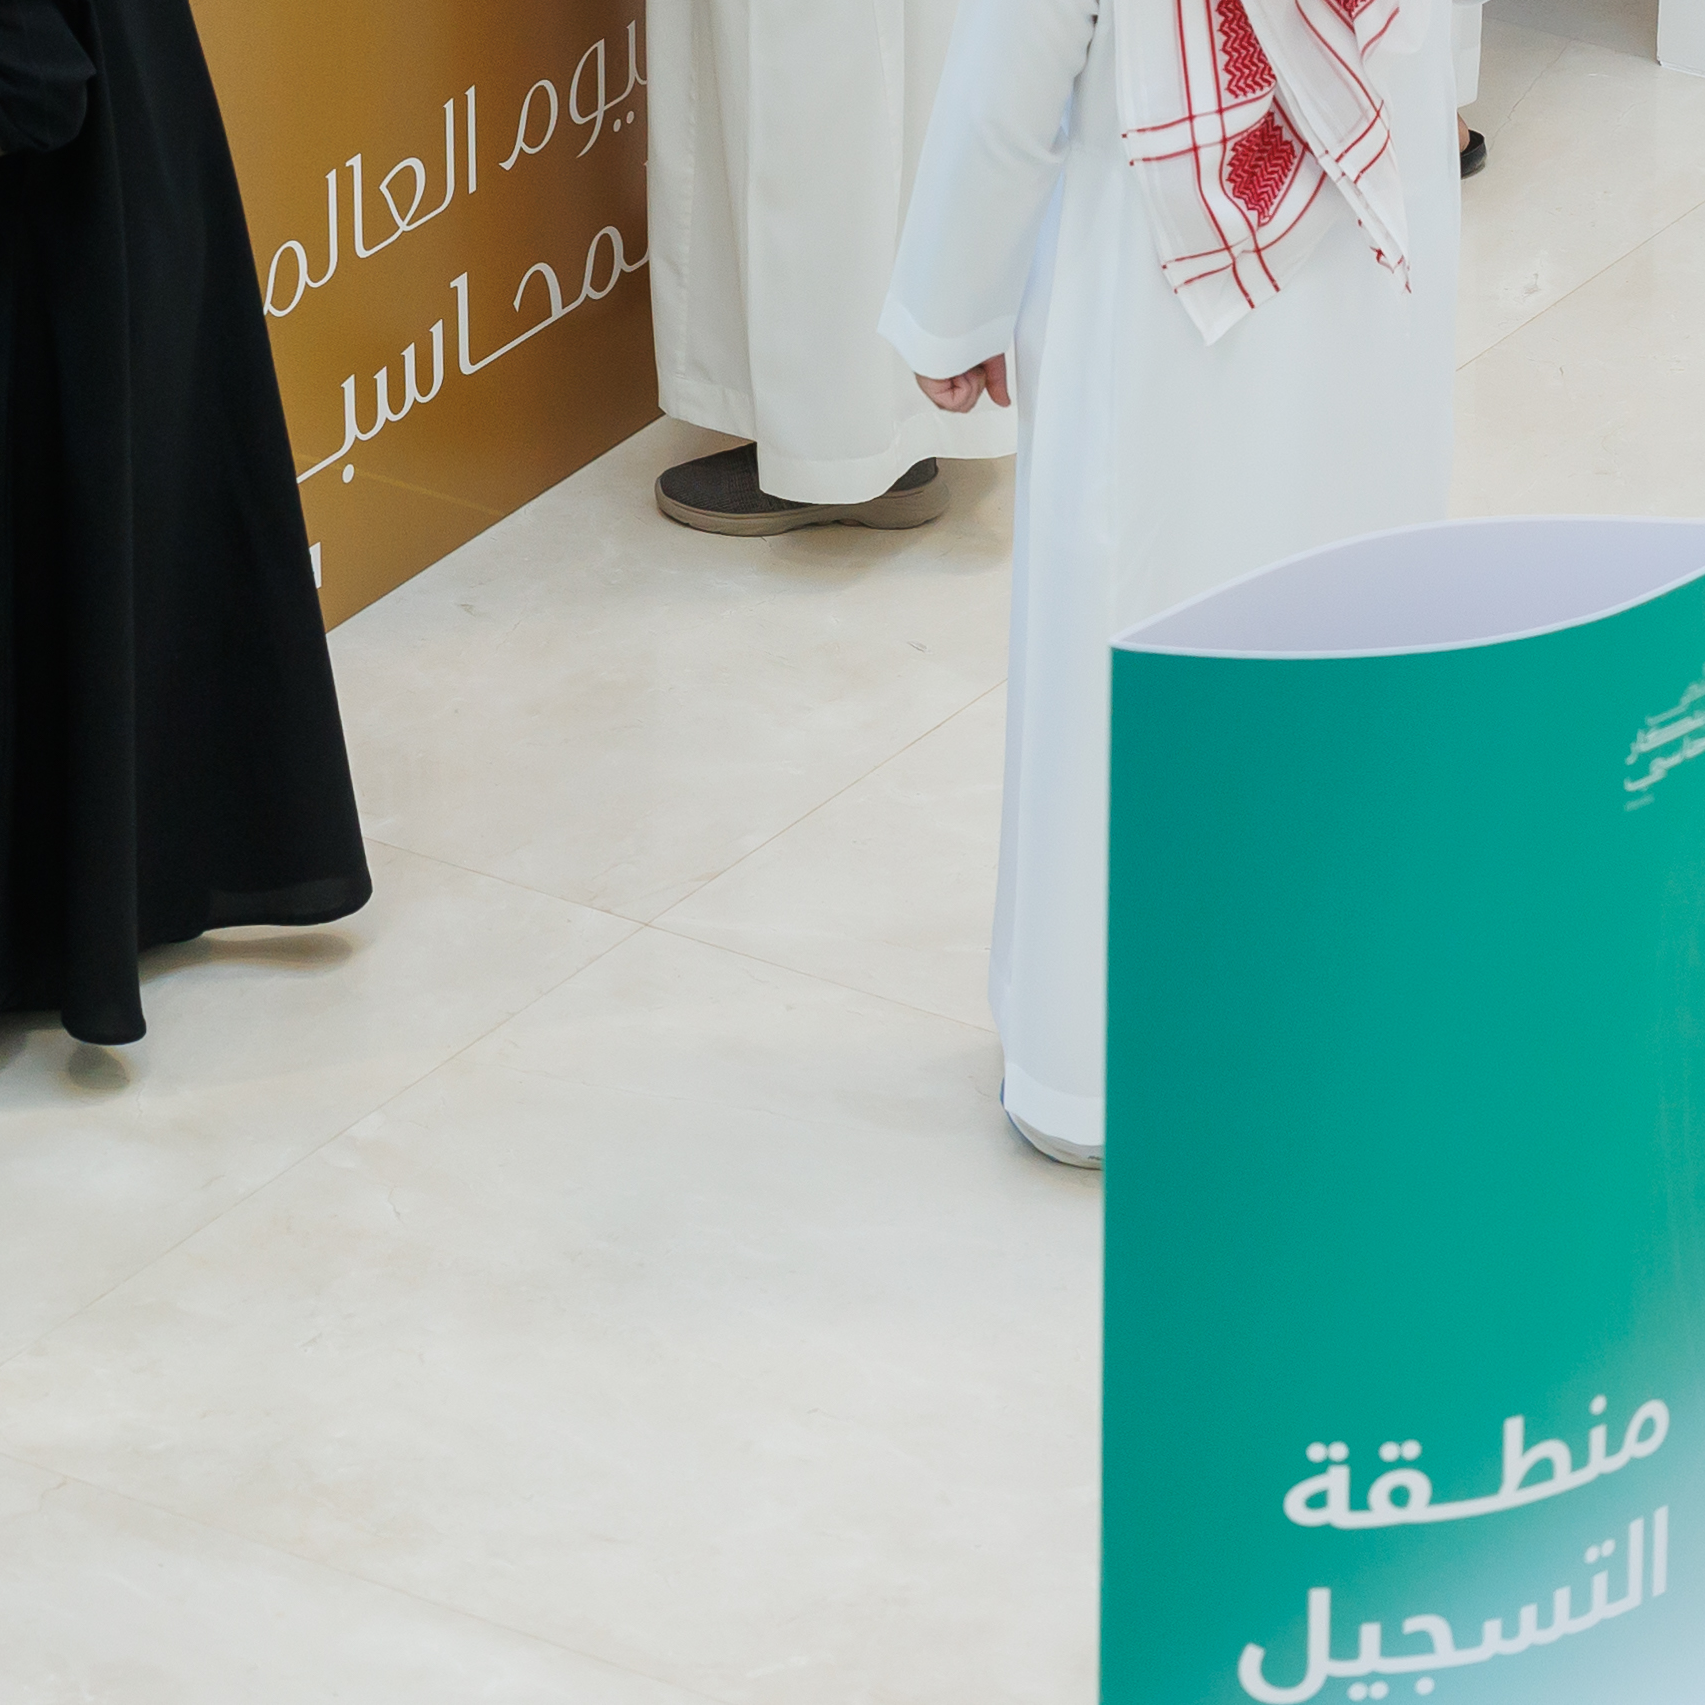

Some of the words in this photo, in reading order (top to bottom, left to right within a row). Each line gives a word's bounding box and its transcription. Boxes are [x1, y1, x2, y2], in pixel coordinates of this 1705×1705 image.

[499, 18, 650, 172] يوم
[263, 83, 478, 318] العالم
[296, 222, 651, 485] محاسب
[1282, 1393, 1672, 1531] منطقة
[1237, 1503, 1670, 1705] التسجيل
